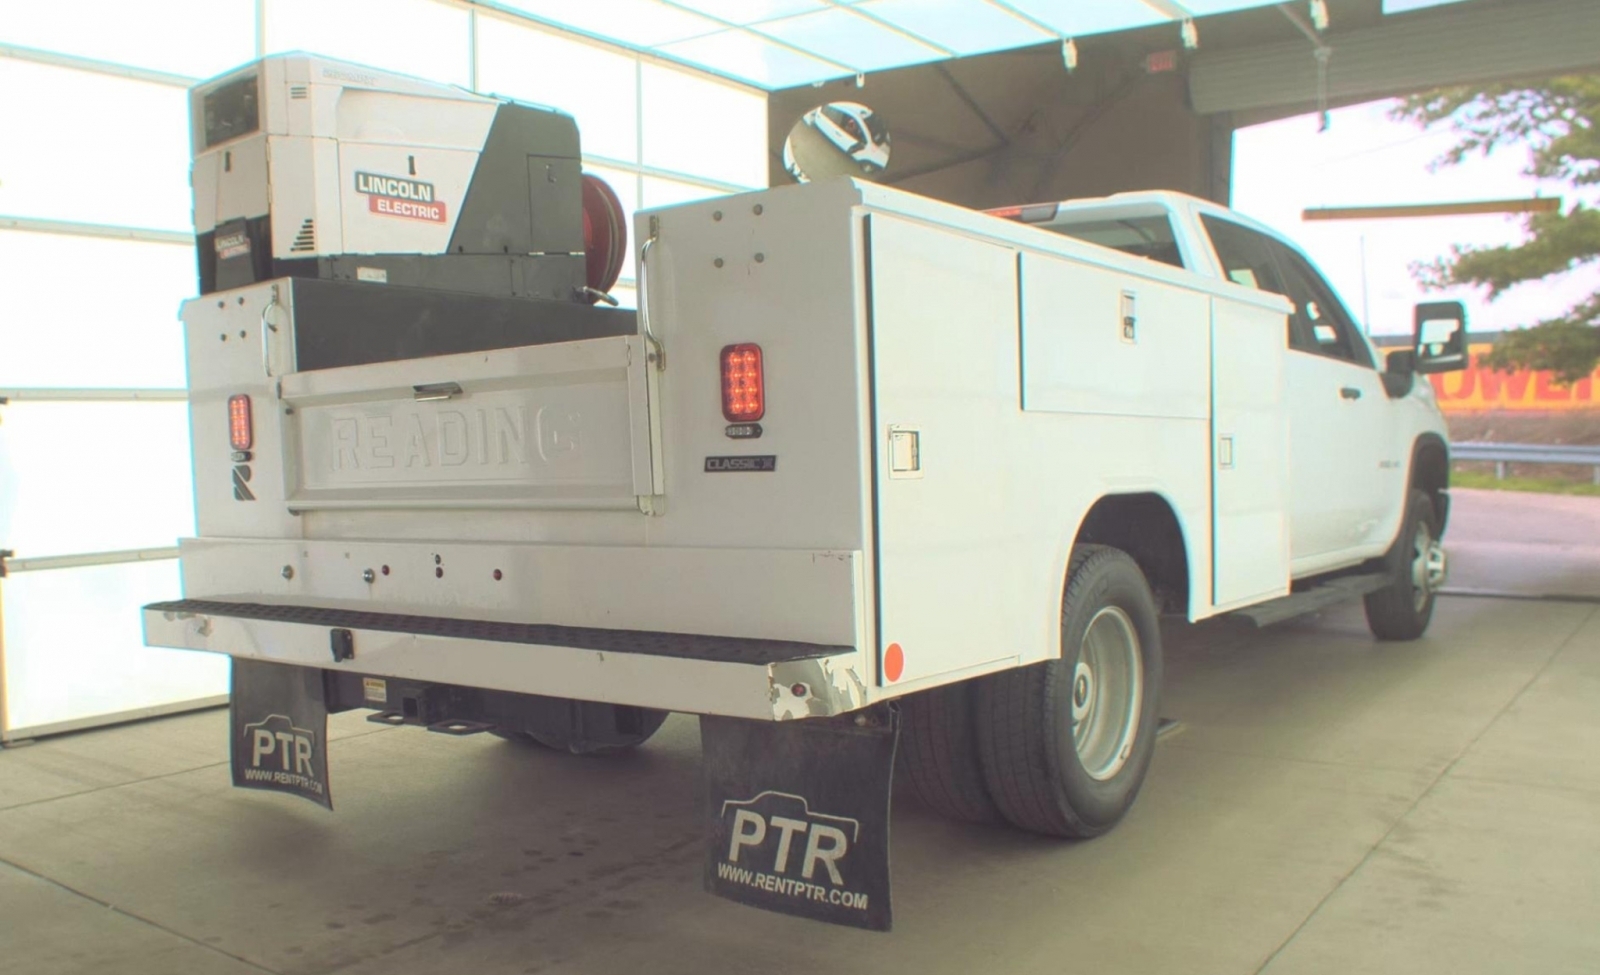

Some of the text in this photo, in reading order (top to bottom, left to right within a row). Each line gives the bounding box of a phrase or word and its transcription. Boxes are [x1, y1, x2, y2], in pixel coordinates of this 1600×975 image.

[358, 173, 432, 203] LINCOLN
[377, 198, 440, 220] ELECTRIC
[331, 404, 586, 472] READING
[706, 458, 760, 470] CLASSIC
[253, 729, 314, 777] PTR
[729, 808, 844, 886] PTR
[717, 861, 869, 910] WWW.RENTPTR.COM
